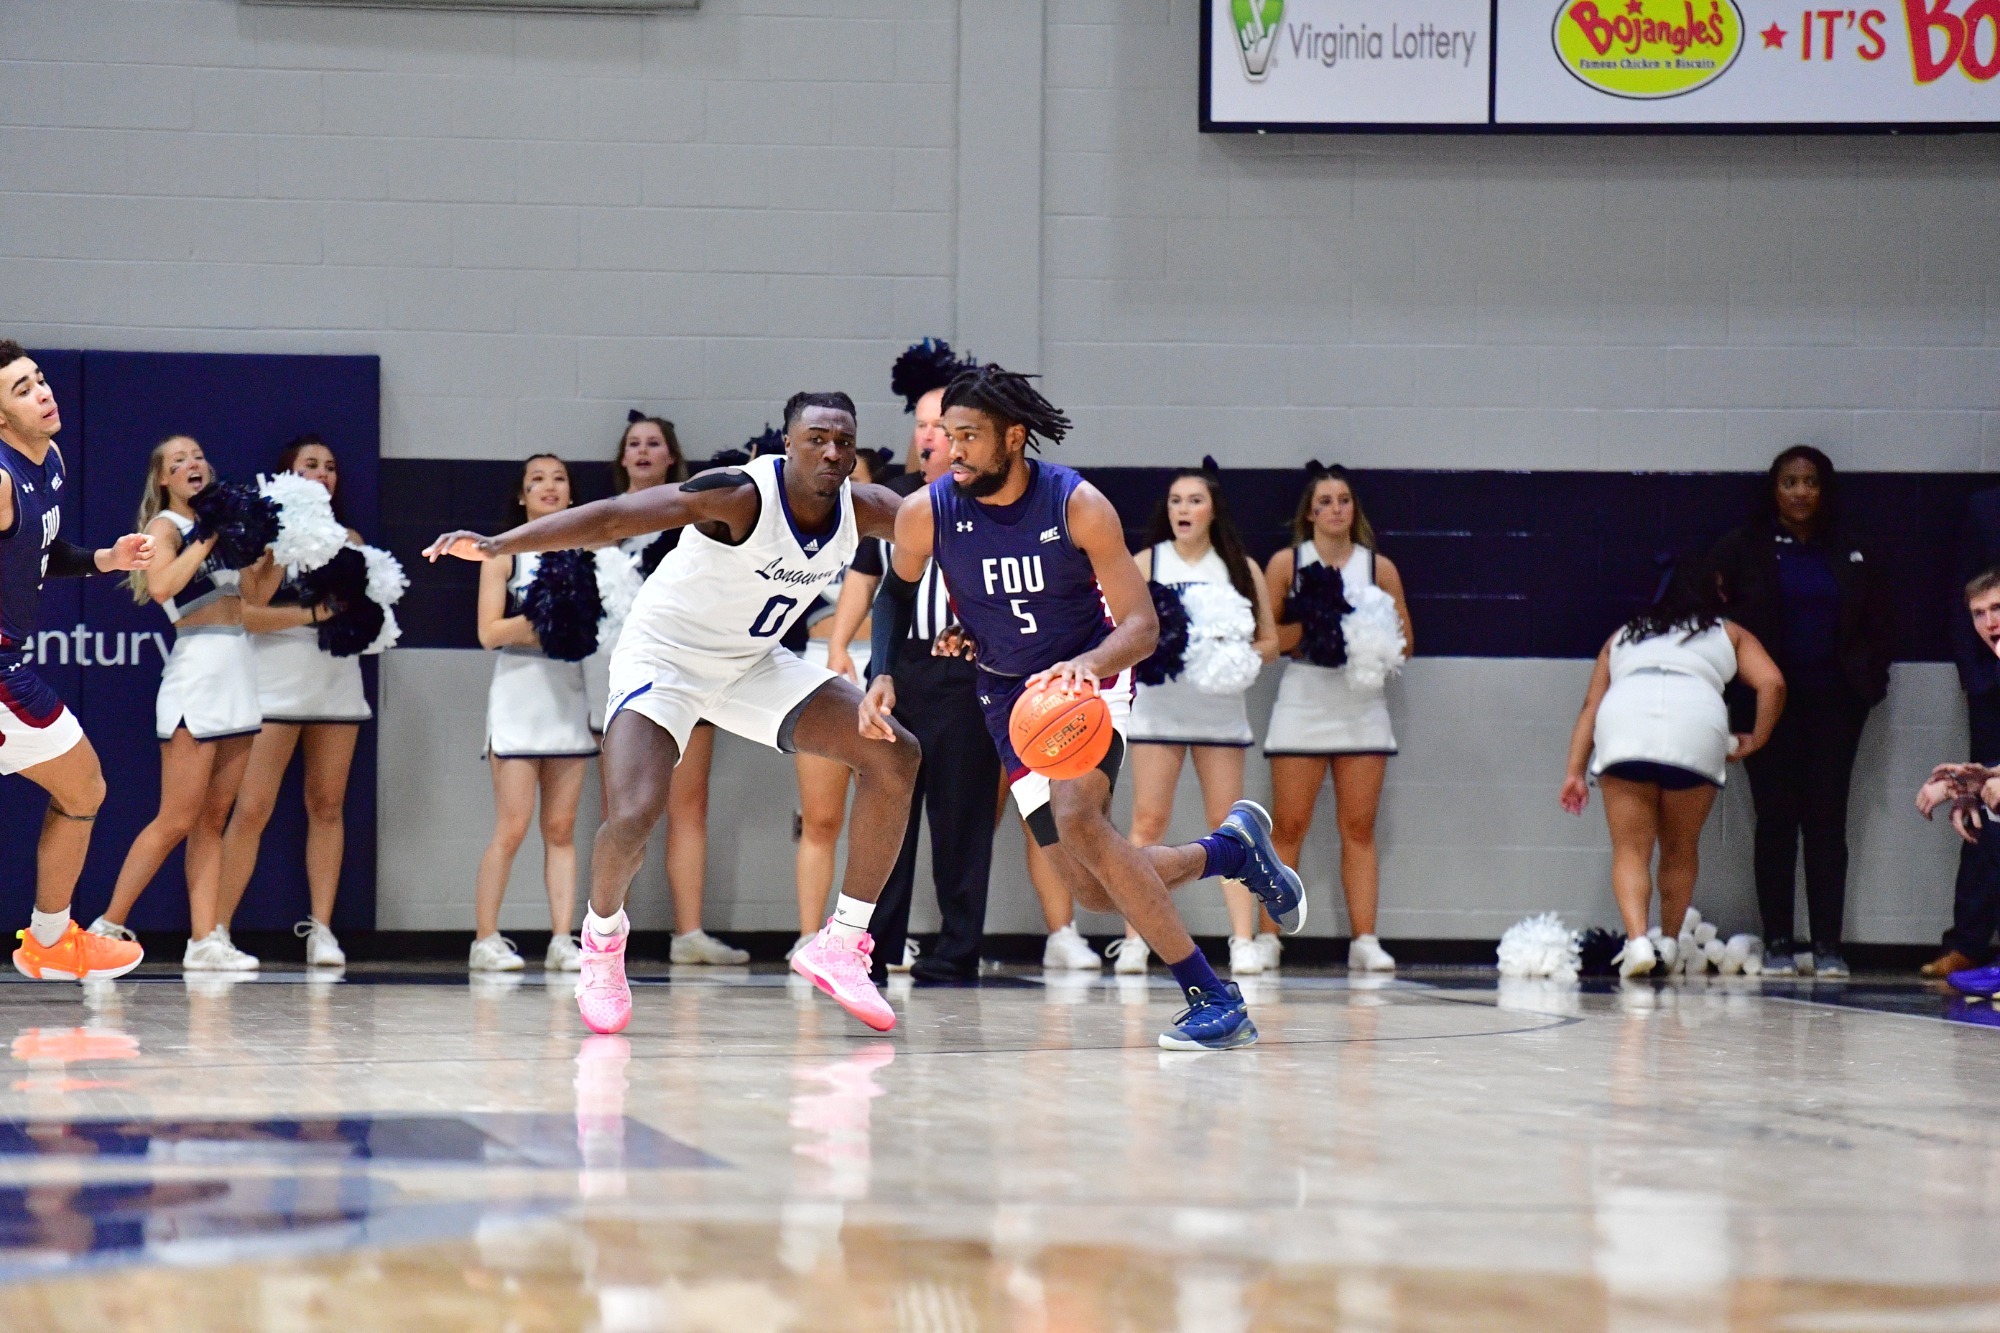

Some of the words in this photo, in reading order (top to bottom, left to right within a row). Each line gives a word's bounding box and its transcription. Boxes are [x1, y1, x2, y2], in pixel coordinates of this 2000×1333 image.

[1289, 22, 1383, 68] Virginia
[1393, 22, 1476, 68] Lottery
[1802, 9, 1886, 61] IT'S
[1579, 59, 1617, 69] Famous
[1620, 59, 1660, 69] Chicken
[1675, 59, 1715, 69] Biscuits
[982, 555, 1044, 595] FDU
[748, 594, 798, 637] 0
[1010, 599, 1037, 634] 5
[1037, 712, 1087, 753] LEGACY
